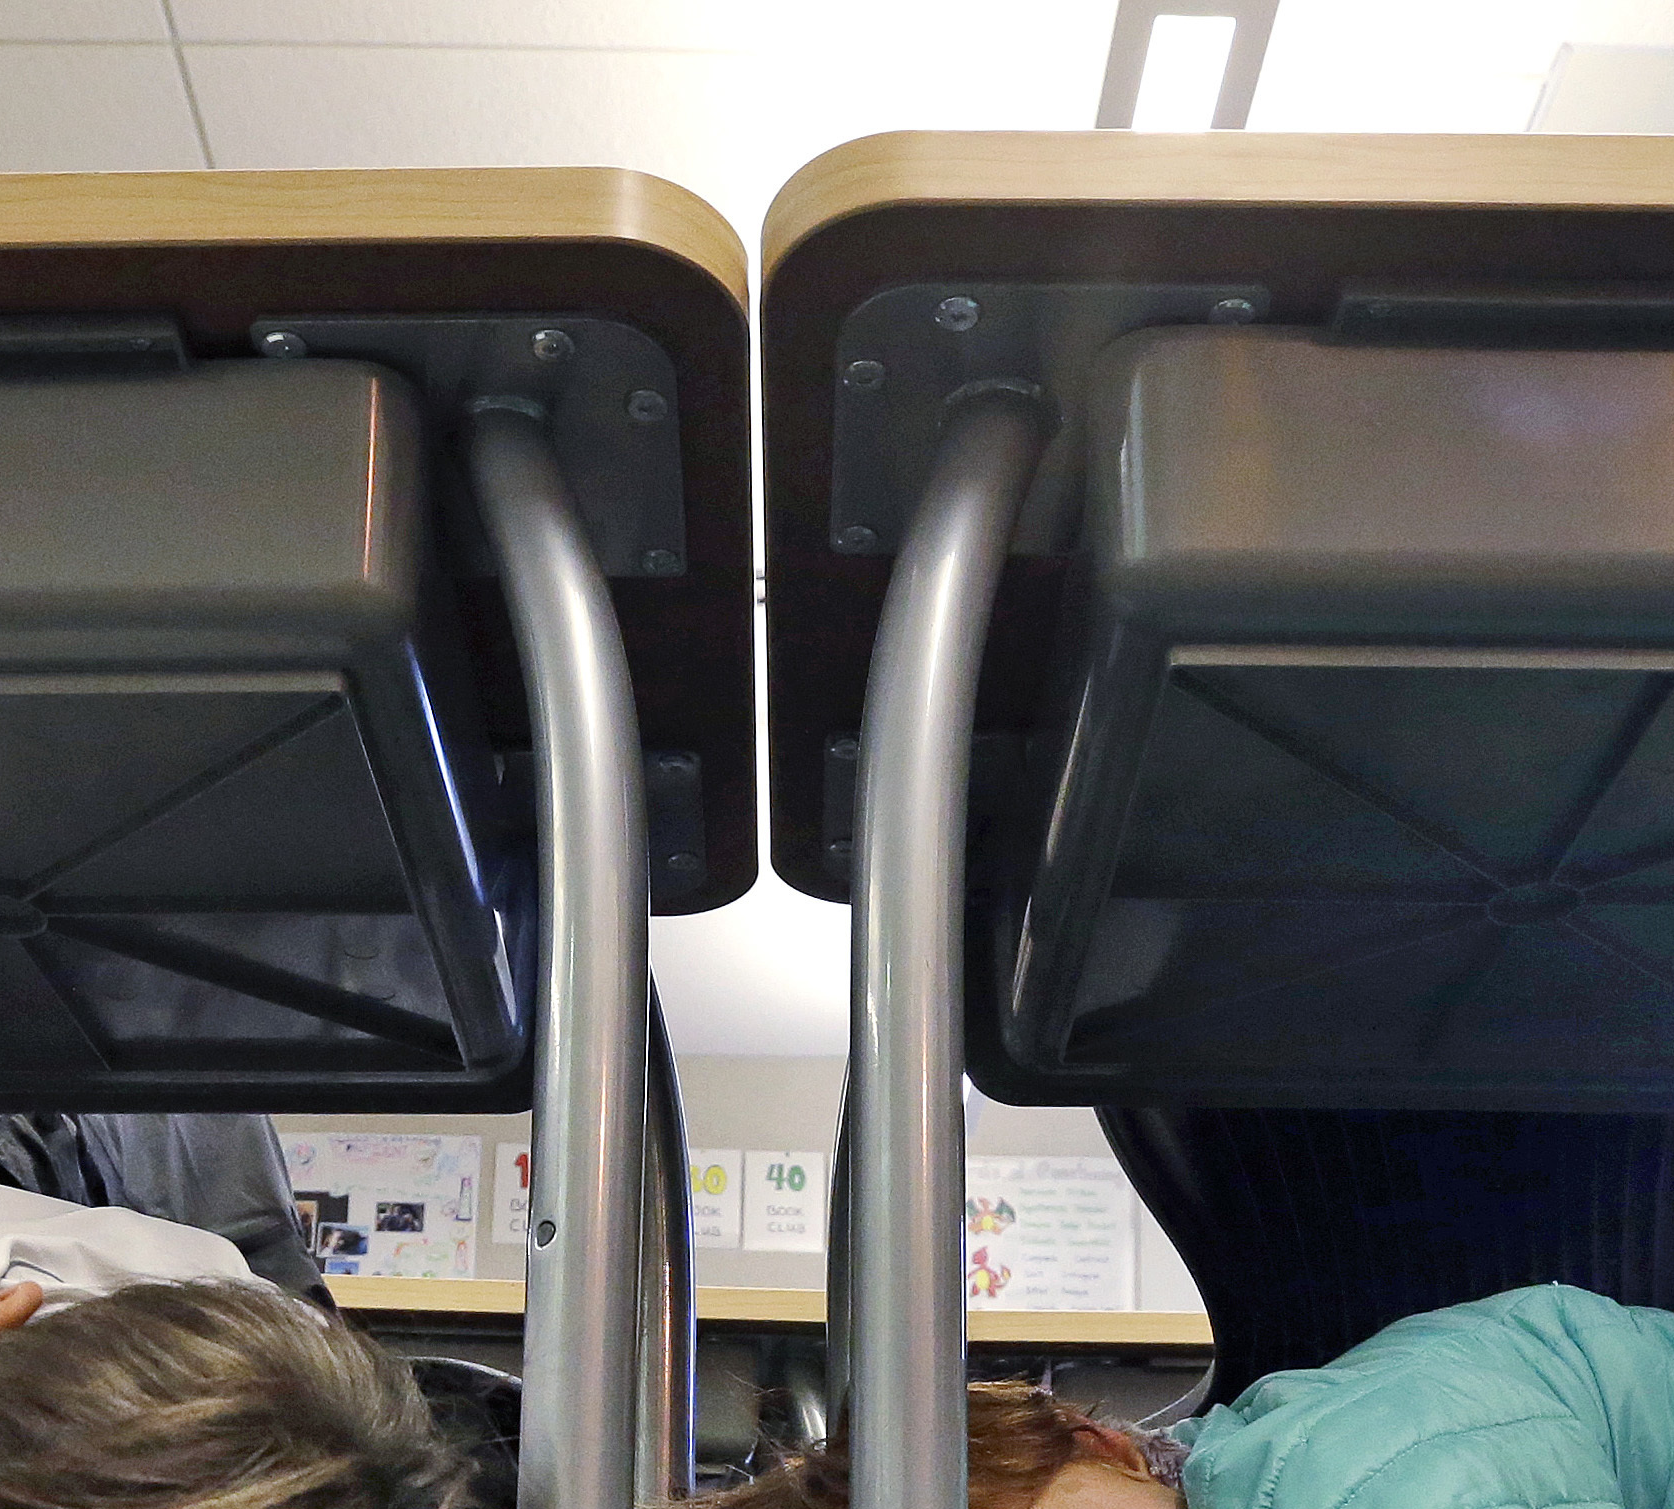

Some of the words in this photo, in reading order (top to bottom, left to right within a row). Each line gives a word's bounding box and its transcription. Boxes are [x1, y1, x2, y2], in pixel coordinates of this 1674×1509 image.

[765, 1162, 807, 1192] 40
[766, 1204, 805, 1217] BOOK
[766, 1221, 807, 1235] CLUB
